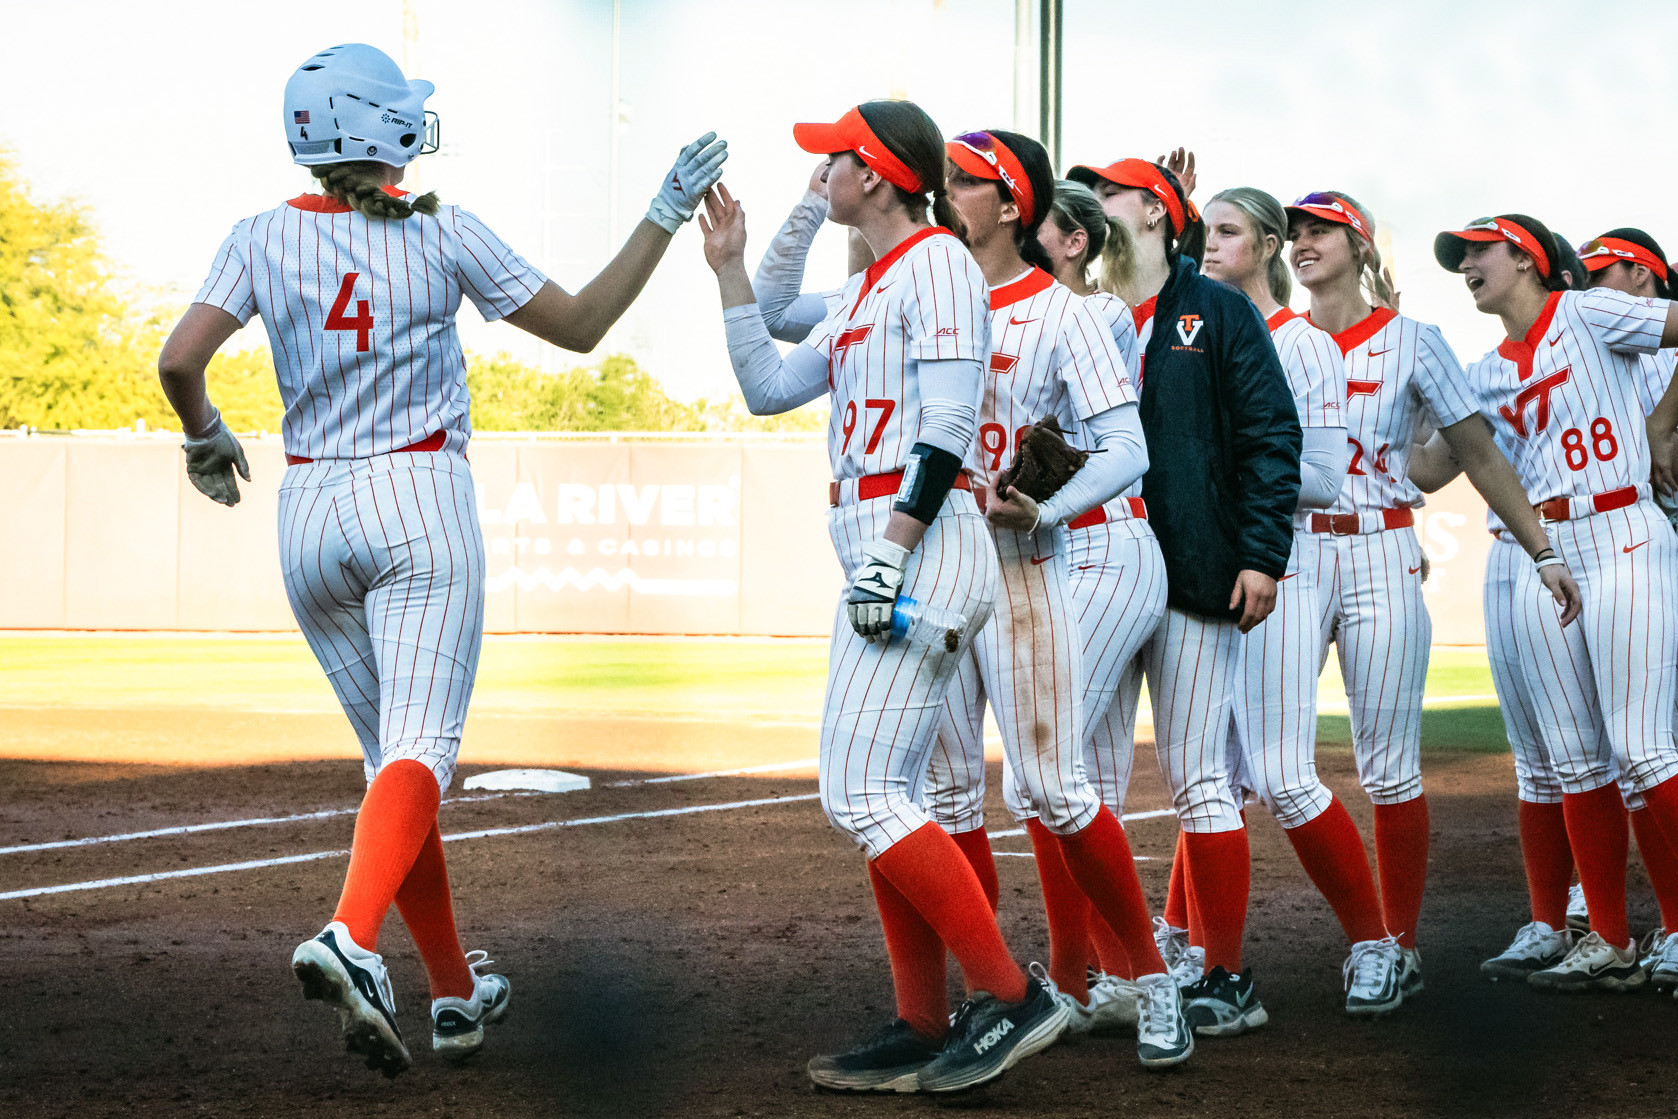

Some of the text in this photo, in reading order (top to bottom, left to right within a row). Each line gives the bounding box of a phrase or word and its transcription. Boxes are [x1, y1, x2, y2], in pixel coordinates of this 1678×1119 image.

[300, 126, 308, 141] 4
[391, 117, 413, 129] RIP-IT
[323, 272, 374, 352] 4
[935, 327, 960, 336] ACC
[1171, 345, 1204, 353] SOFTBALL
[841, 398, 896, 456] 97
[1561, 416, 1618, 472] 88
[557, 483, 738, 526] RIVER
[597, 538, 738, 558] CASINOS
[973, 1017, 1015, 1055] HOKA
